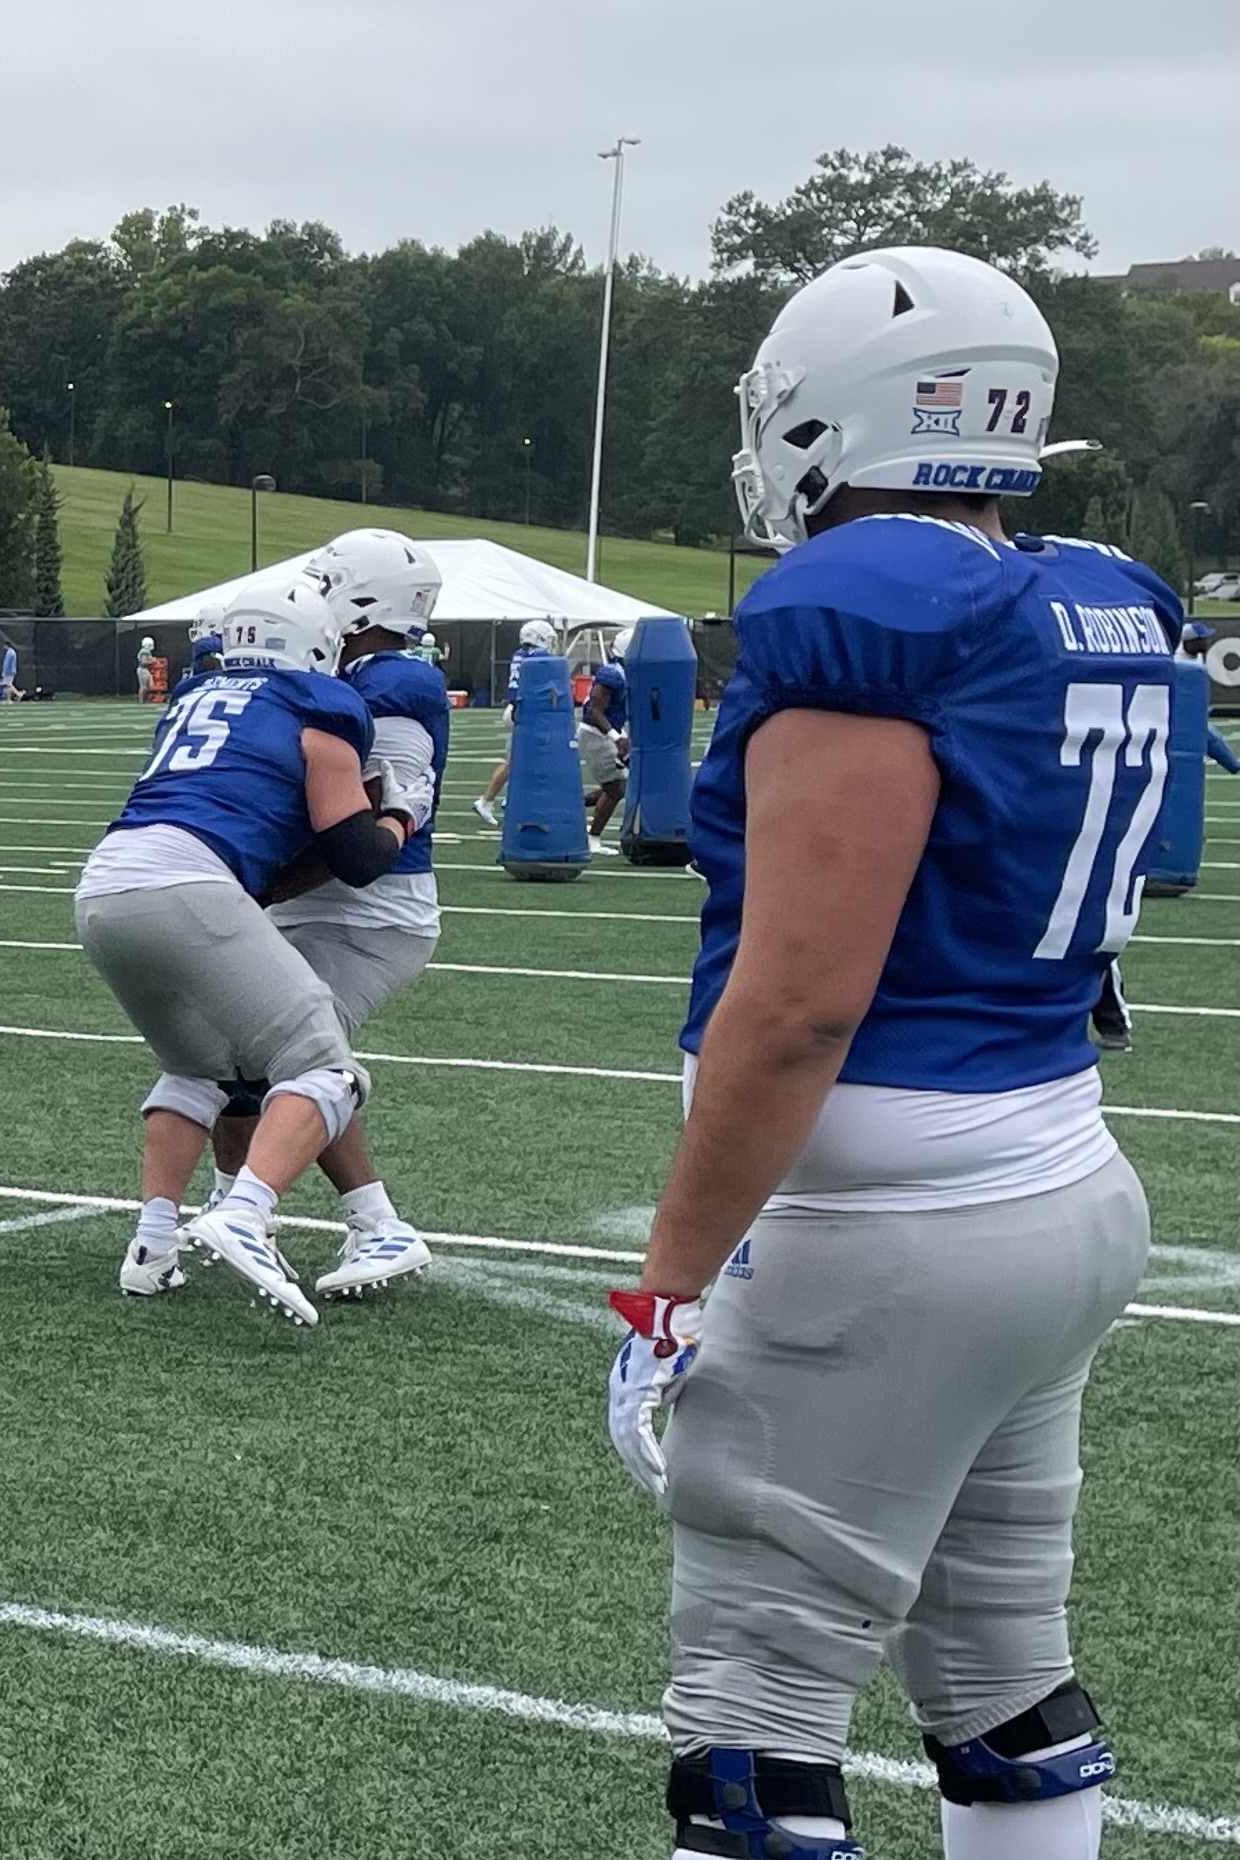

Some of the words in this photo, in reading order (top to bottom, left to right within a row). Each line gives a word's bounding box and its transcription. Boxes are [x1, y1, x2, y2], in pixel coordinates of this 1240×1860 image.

[985, 388, 1031, 434] 72
[912, 462, 986, 489] ROCK
[236, 626, 257, 645] 75
[139, 689, 252, 782] 75
[1032, 682, 1170, 960] 72
